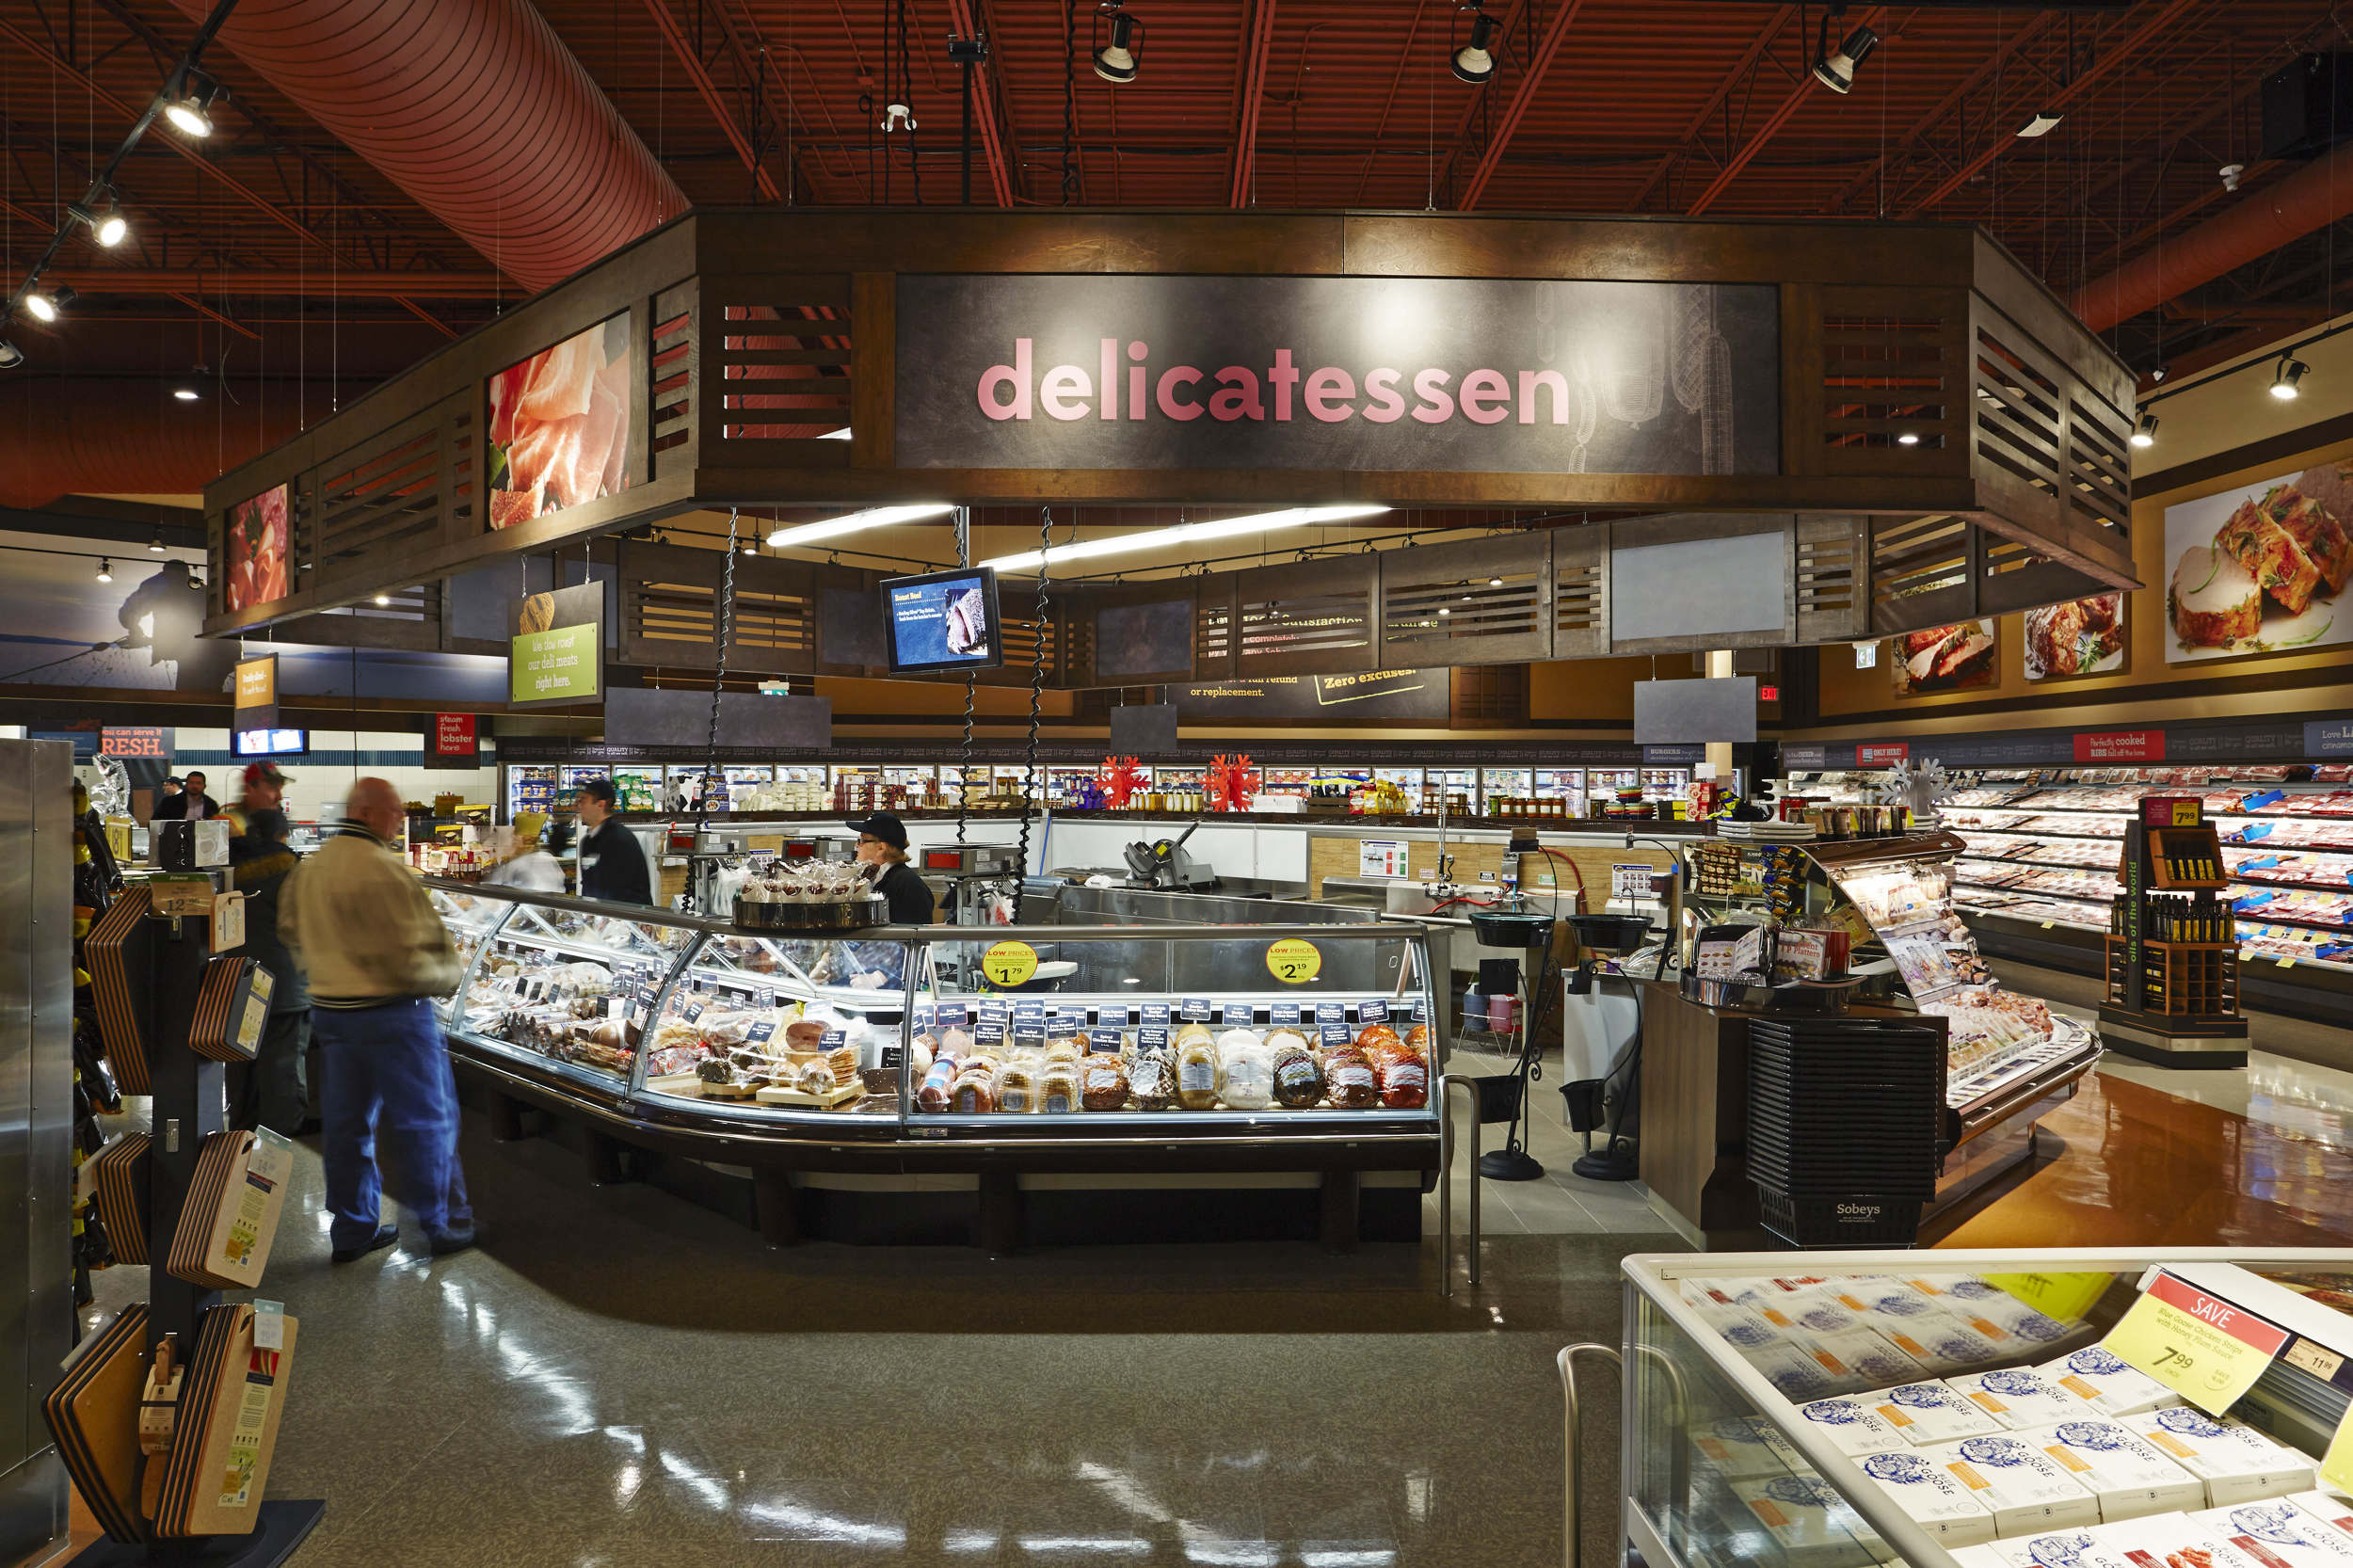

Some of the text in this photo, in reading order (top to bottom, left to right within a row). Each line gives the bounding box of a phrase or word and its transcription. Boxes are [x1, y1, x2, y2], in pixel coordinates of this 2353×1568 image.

[978, 338, 1569, 424] delicatessen
[528, 654, 579, 671] our deli meats
[536, 676, 552, 692] right
[1203, 686, 1265, 698] replacement.
[1323, 676, 1356, 689] Zero
[1762, 687, 1777, 699] EXIT
[156, 728, 163, 737] it
[440, 733, 472, 744] lobster
[2116, 734, 2146, 745] cooked
[2322, 730, 2342, 739] Love
[2129, 861, 2137, 897] world
[2129, 901, 2137, 920] the
[2129, 941, 2137, 963] oils
[1837, 1204, 1881, 1218] Sobeys
[2190, 1297, 2235, 1329] SAVE
[2034, 1383, 2068, 1403] GOOSE
[1941, 1395, 1973, 1416] GOOSE
[1852, 1411, 1881, 1432] GOOSE
[2219, 1422, 2264, 1448] GOOSE
[2116, 1435, 2156, 1463] GOOSE
[2017, 1450, 2055, 1478] GOOSE
[1921, 1468, 1954, 1496] GOOSE
[2302, 1526, 2352, 1557] GOOSE
